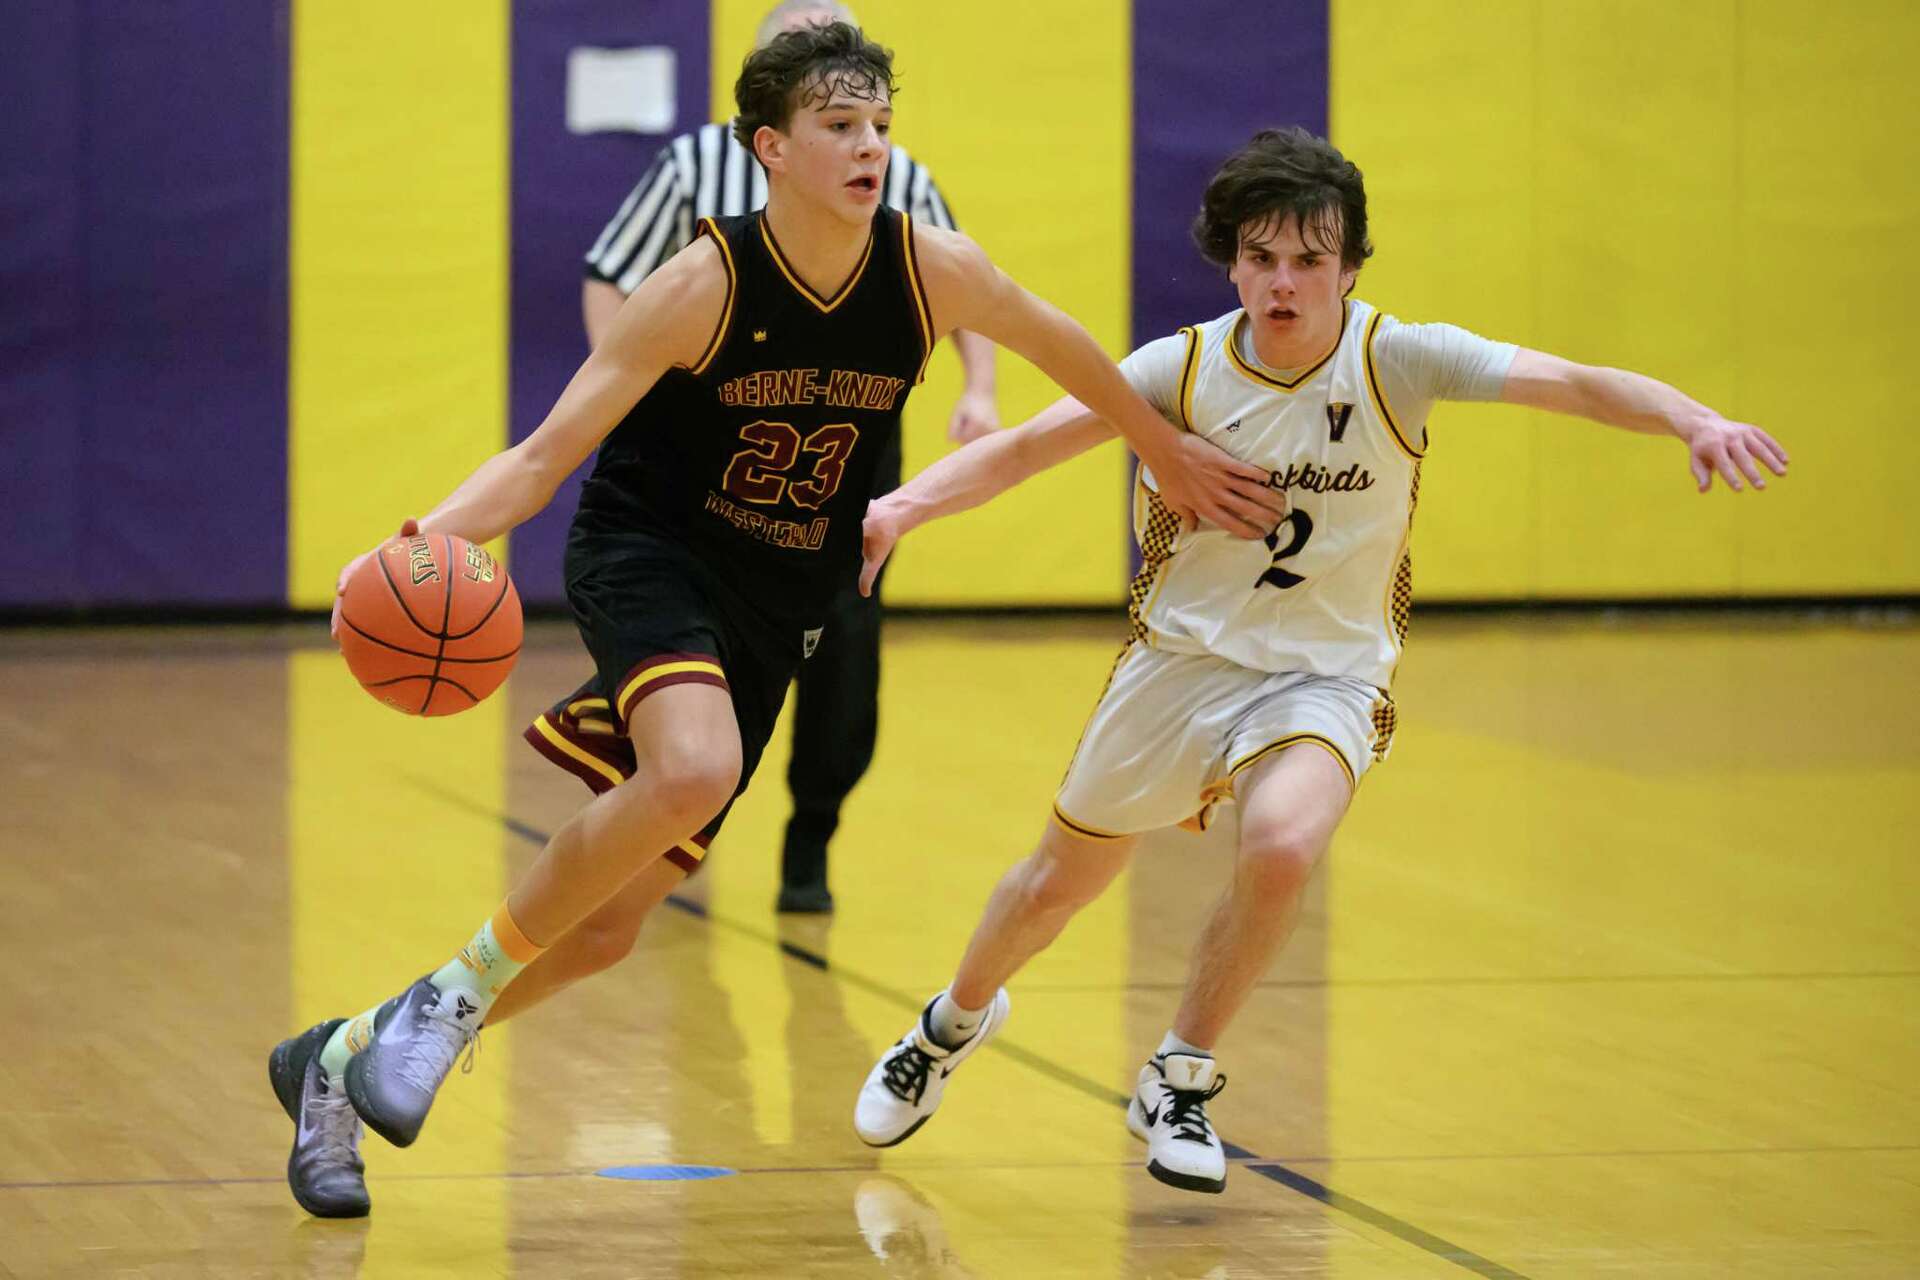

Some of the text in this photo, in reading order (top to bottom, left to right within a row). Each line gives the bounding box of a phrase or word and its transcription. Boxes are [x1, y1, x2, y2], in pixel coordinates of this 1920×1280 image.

[718, 368, 905, 410] BERNE-KNOX
[722, 419, 860, 510] 23
[1260, 462, 1376, 494] ckbirds
[1254, 508, 1314, 589] 2
